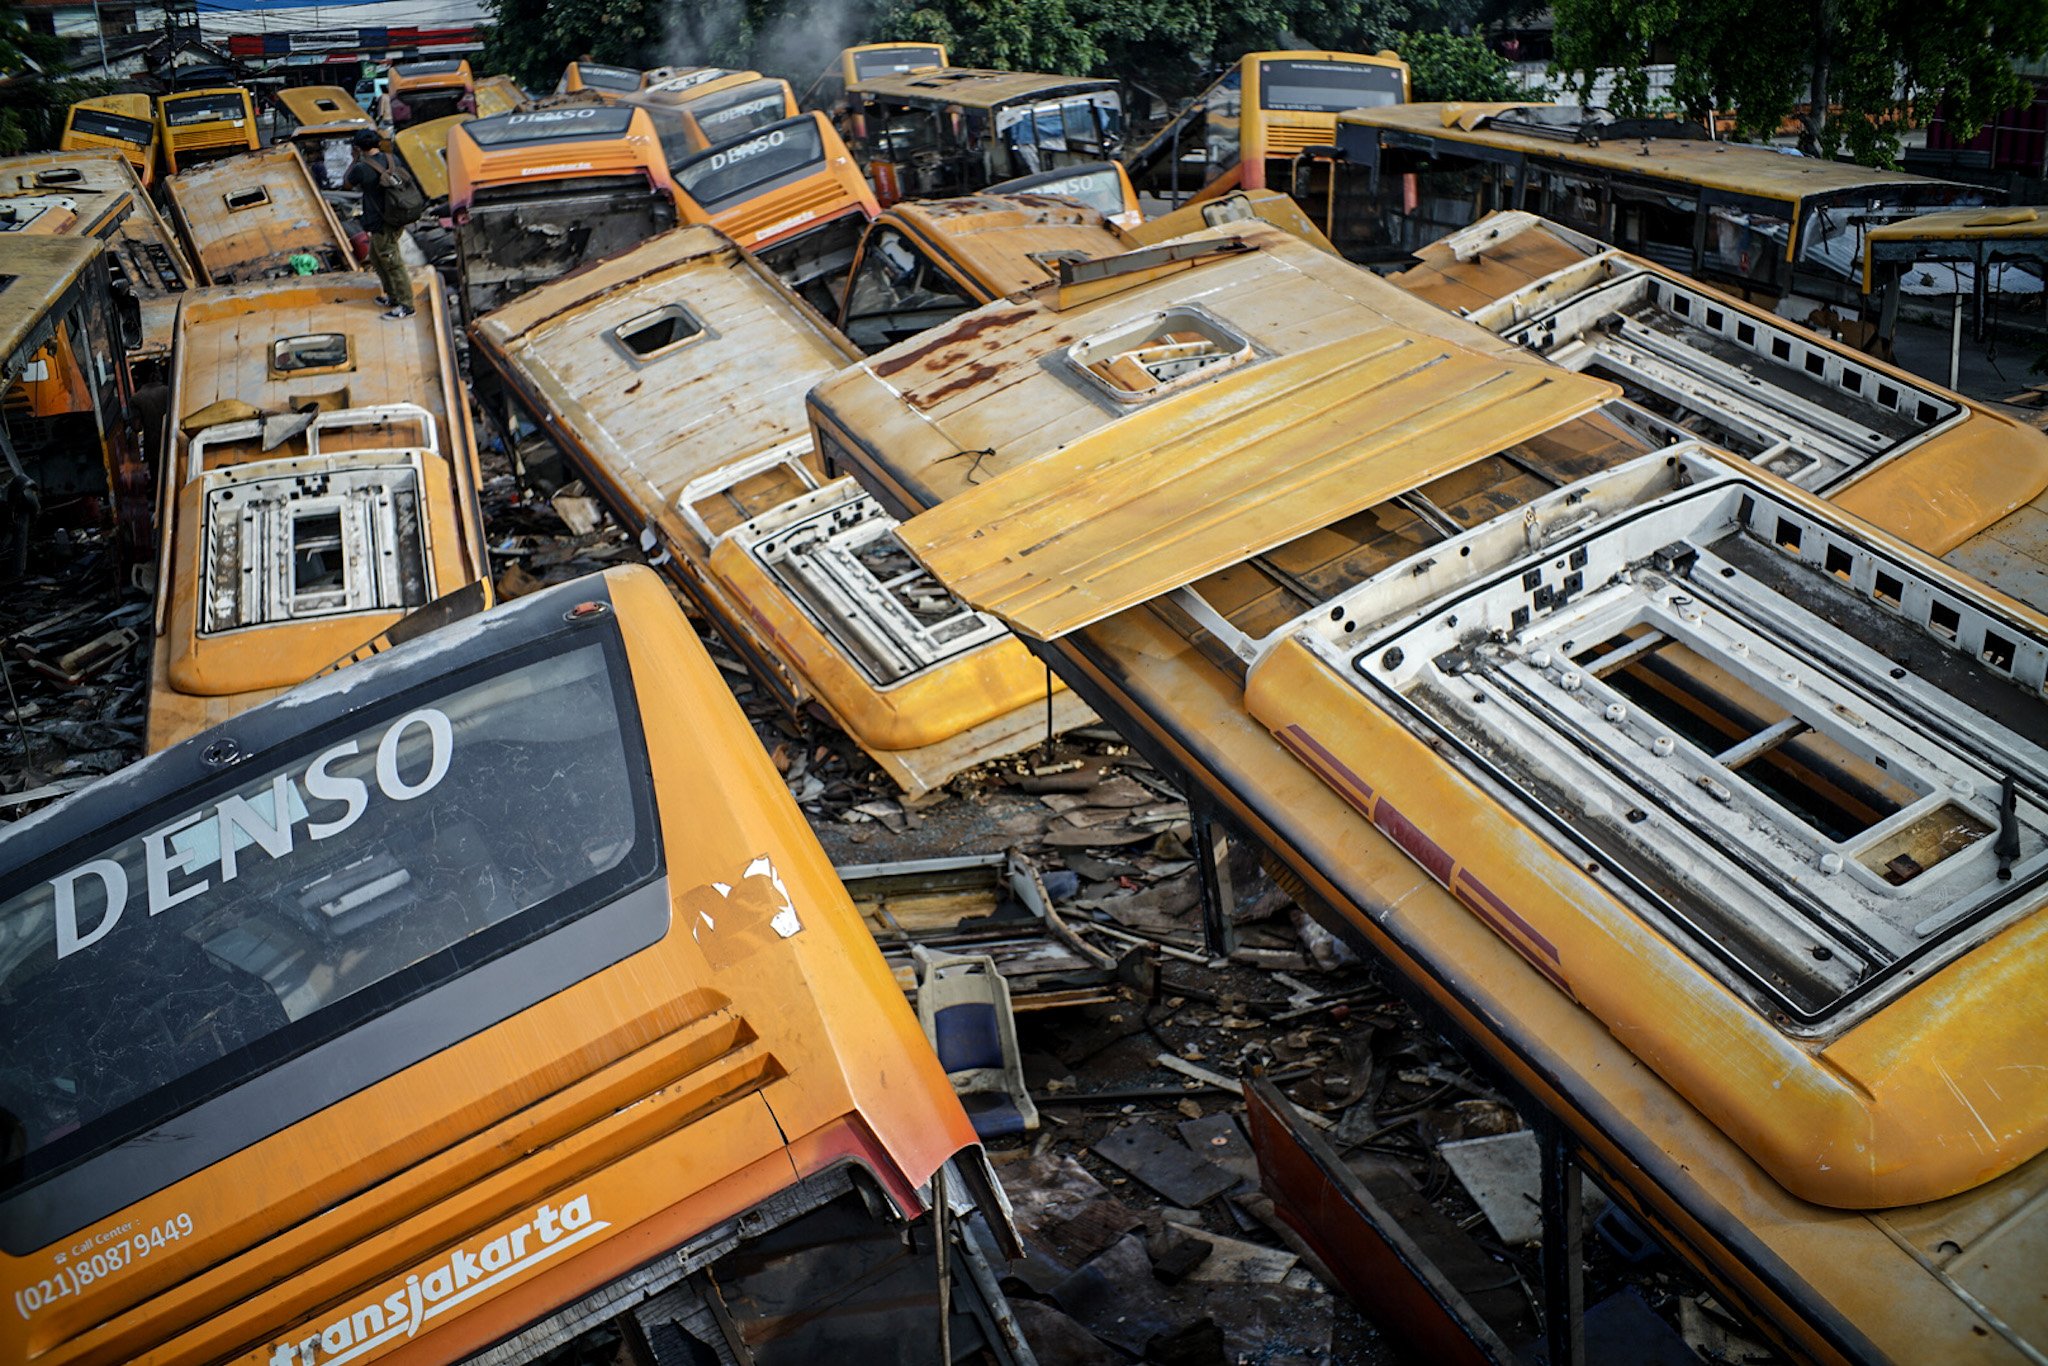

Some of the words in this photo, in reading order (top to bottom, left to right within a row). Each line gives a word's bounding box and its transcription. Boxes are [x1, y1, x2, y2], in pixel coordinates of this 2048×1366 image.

[508, 109, 596, 125] DENSO
[718, 100, 765, 124] DENSO
[710, 129, 785, 171] DENSO
[49, 708, 454, 961] DENSO
[72, 1238, 94, 1257] Call
[95, 1221, 133, 1245] Center
[15, 1212, 194, 1320] (021)80879449
[269, 1194, 593, 1366] transjakarta
